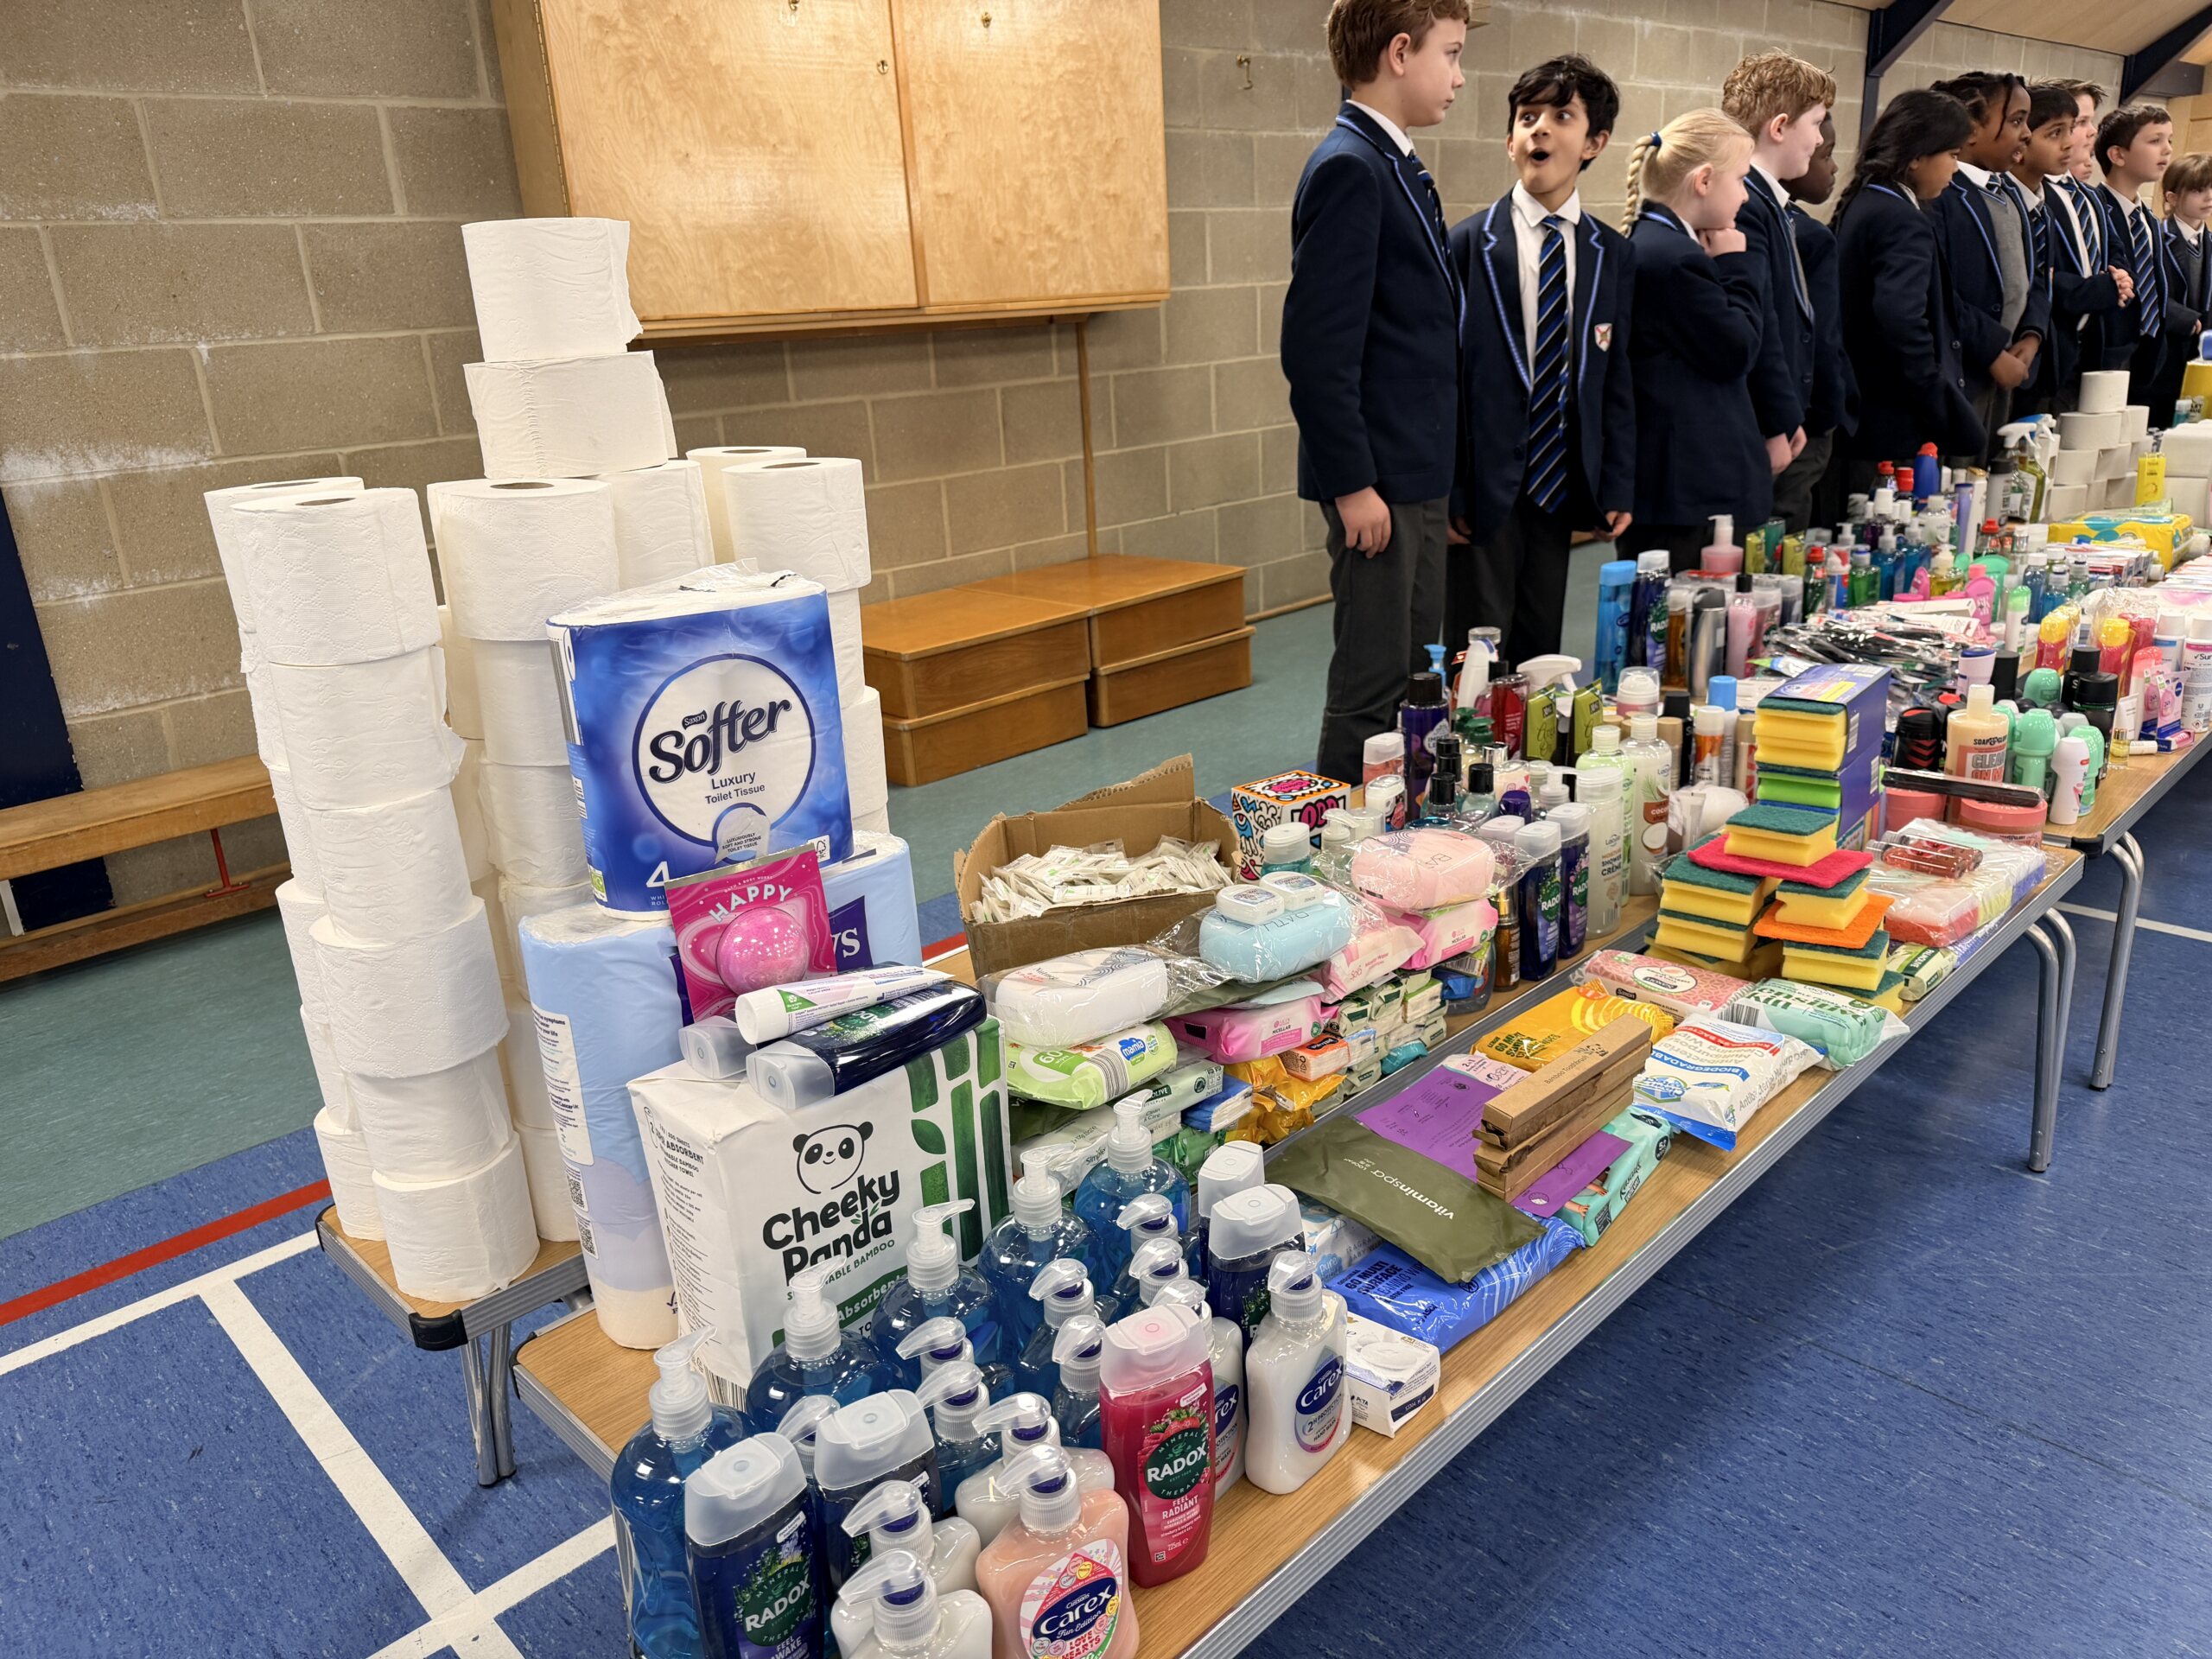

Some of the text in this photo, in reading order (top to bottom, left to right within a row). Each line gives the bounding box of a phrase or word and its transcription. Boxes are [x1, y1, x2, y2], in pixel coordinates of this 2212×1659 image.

[684, 714, 706, 727] Saxon
[649, 699, 791, 784] Softer
[711, 772, 756, 790] Luxury
[705, 784, 766, 804] Toilet Tissue
[646, 861, 671, 888] 4
[1573, 881, 1588, 896] RADO
[709, 883, 792, 923] HAPPY
[1541, 894, 1561, 911] RADO
[1272, 1025, 1291, 1034] MICELLAR
[1039, 1050, 1063, 1065] 60
[1122, 1039, 1145, 1058] mamia
[1669, 1038, 1751, 1060] Multipurpos
[1544, 1070, 1565, 1084] Bamboo
[1564, 1055, 1590, 1072] Toothbrush
[1651, 1050, 1739, 1074] BIODEGRADABL
[666, 1141, 704, 1165] ABSORBENT
[1370, 1169, 1454, 1219] vitaminspa
[762, 1169, 900, 1250] Cheeky
[782, 1211, 893, 1287] Panda
[854, 1239, 895, 1268] BAMBOO
[1319, 1256, 1338, 1274] pure
[1344, 1260, 1390, 1290] 60 MULTI
[1357, 1264, 1403, 1295] SURFACE
[1371, 1272, 1412, 1298] LEANING
[1215, 1390, 1237, 1424] rex
[1159, 1431, 1199, 1454] MINERAL
[1216, 1422, 1237, 1447] OTECTION
[1147, 1443, 1207, 1483] RADOX
[1162, 1495, 1198, 1520] RADIANT
[1173, 1495, 1190, 1508] FEEL
[756, 1565, 800, 1599] MINERAL
[745, 1573, 810, 1632] RADOX
[1056, 1610, 1103, 1638] Fun Edition
[776, 1635, 795, 1652] FEEL
[1069, 1630, 1093, 1649] LOVE
